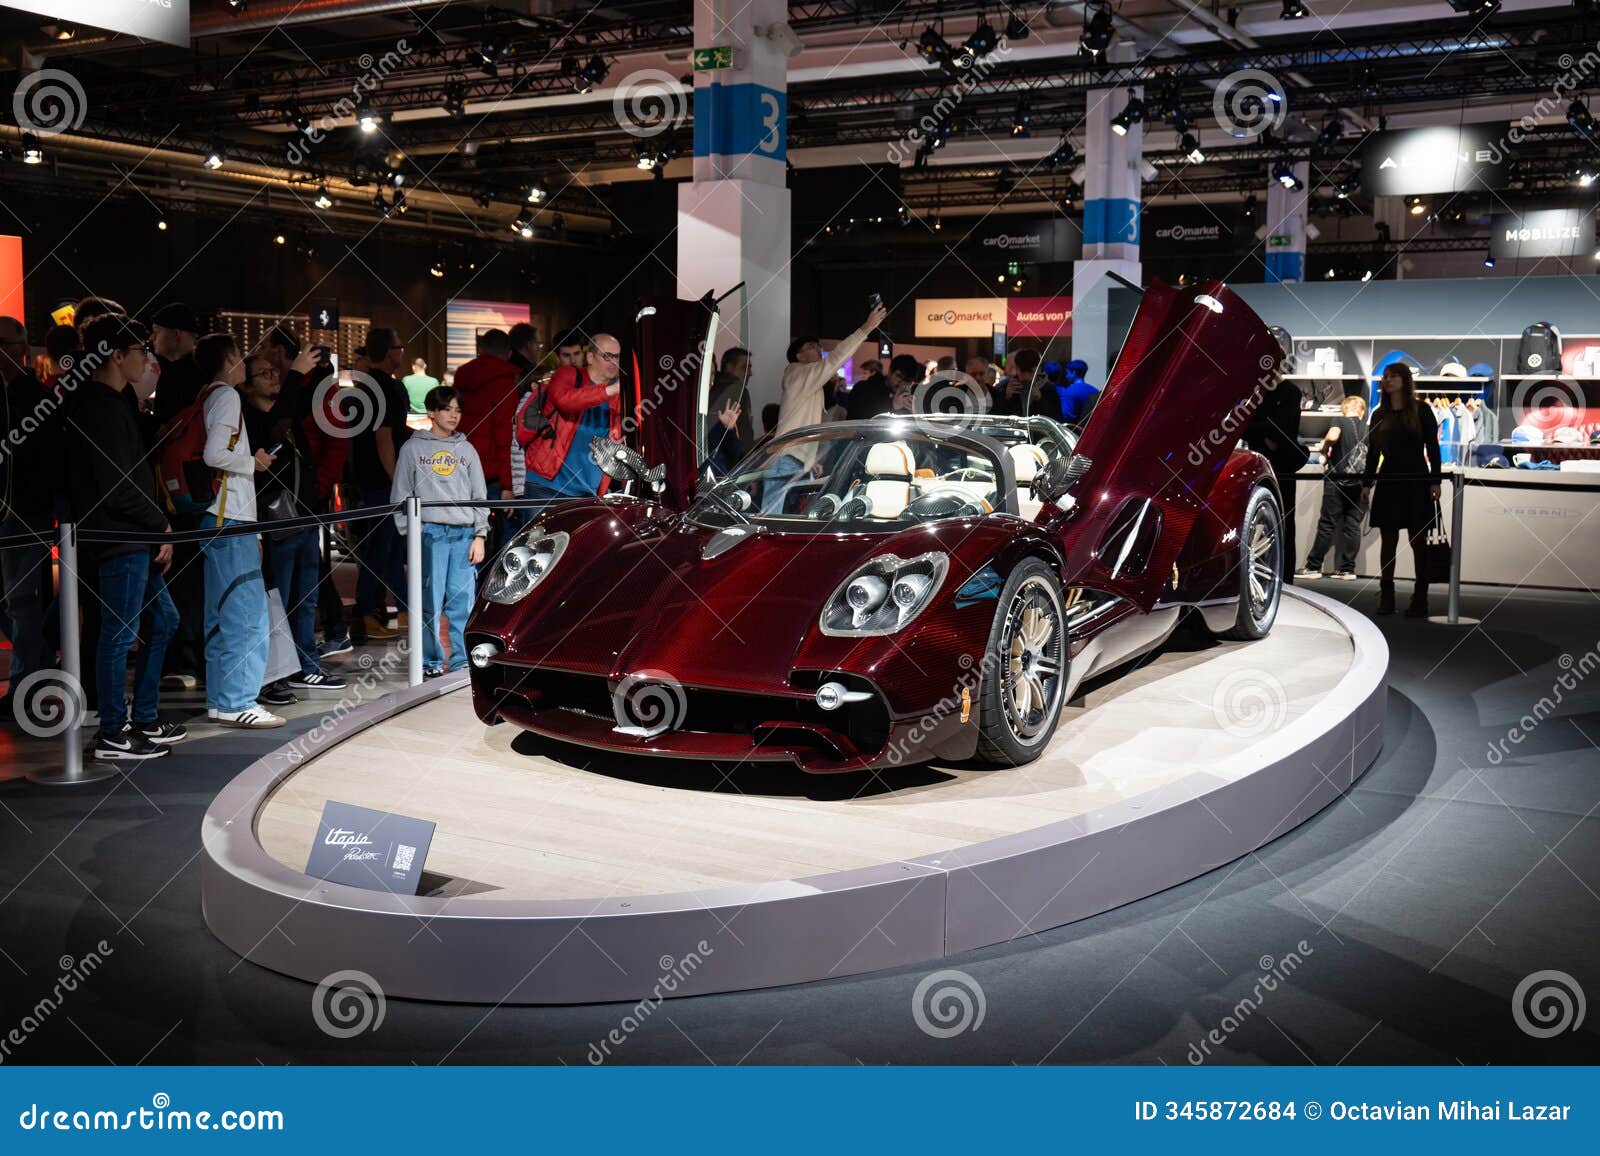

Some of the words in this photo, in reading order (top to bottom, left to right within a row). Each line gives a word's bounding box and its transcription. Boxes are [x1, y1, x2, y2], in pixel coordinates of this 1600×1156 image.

[761, 92, 780, 153] 3
[1128, 203, 1138, 241] 3
[1016, 311, 1045, 322] Autos
[1046, 312, 1064, 321] von
[419, 455, 443, 465] Hard
